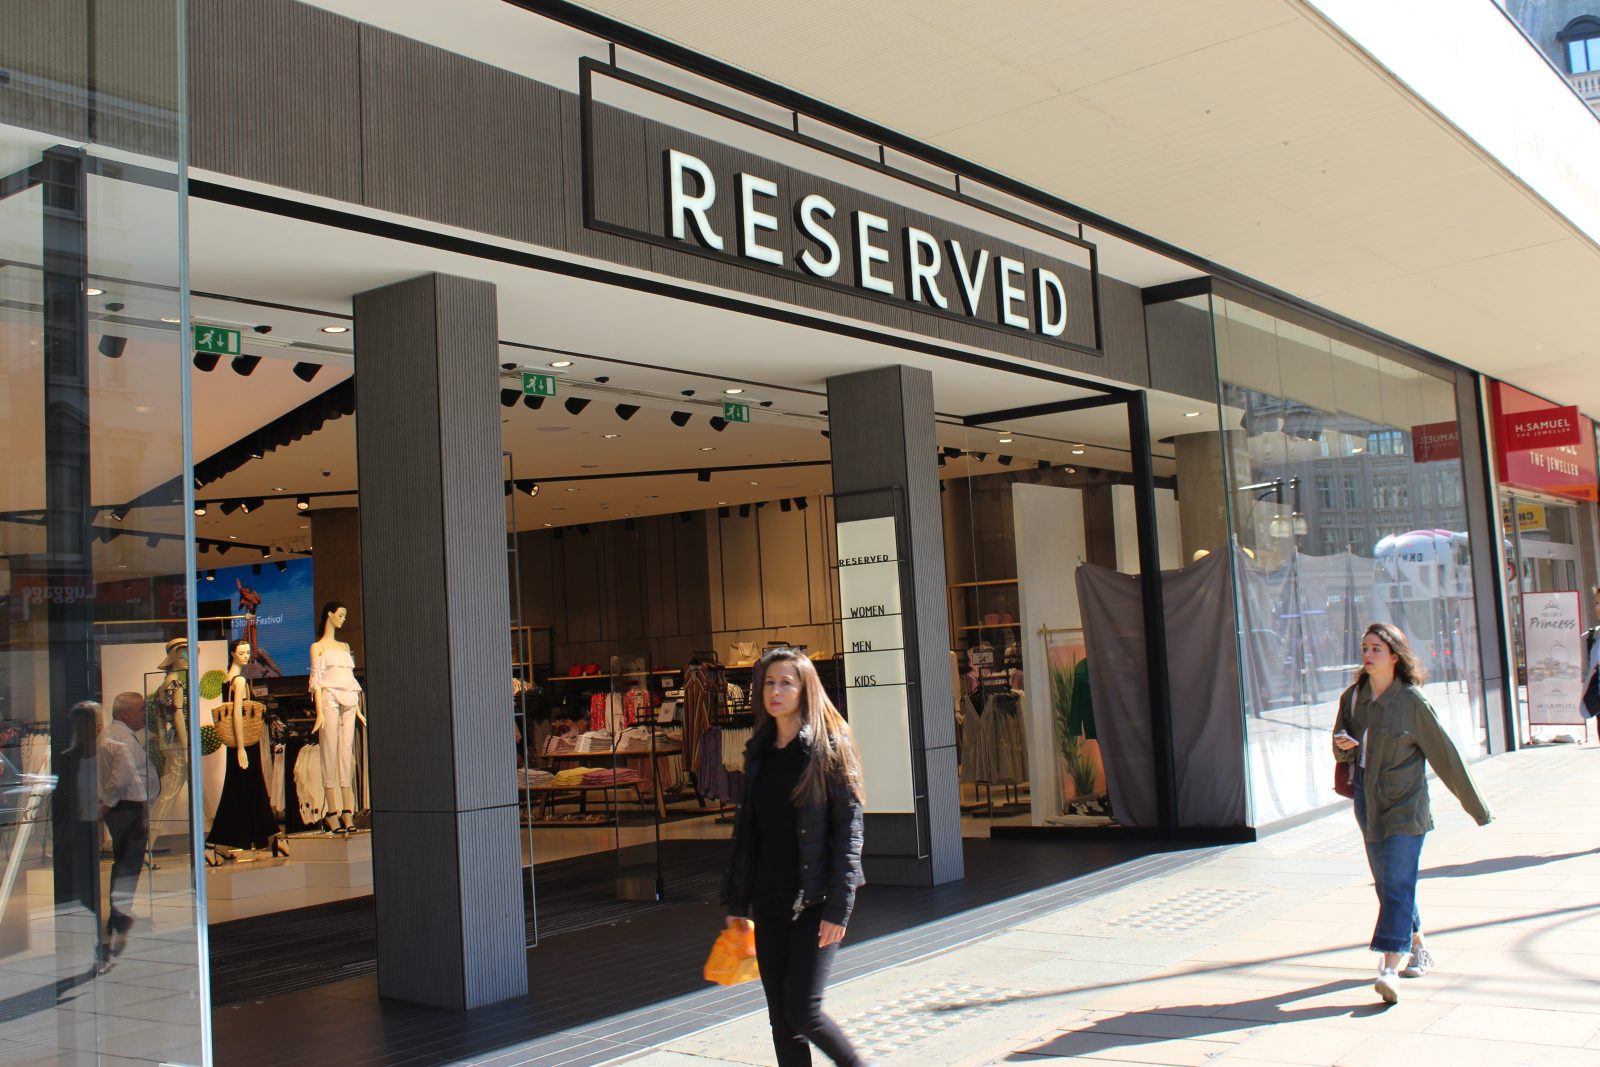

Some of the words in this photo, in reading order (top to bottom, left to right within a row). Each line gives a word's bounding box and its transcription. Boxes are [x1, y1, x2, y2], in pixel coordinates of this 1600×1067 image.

[664, 148, 1068, 338] RESERVED
[1515, 418, 1571, 433] H.SAMUEL
[1529, 451, 1544, 467] THE
[1546, 456, 1579, 477] JEWELLER
[838, 554, 889, 567] RESERVED
[850, 604, 885, 618] WOMEN
[256, 613, 283, 625] Festival
[1529, 616, 1576, 630] Princess
[852, 640, 872, 653] MEN
[854, 674, 877, 687] KIDS
